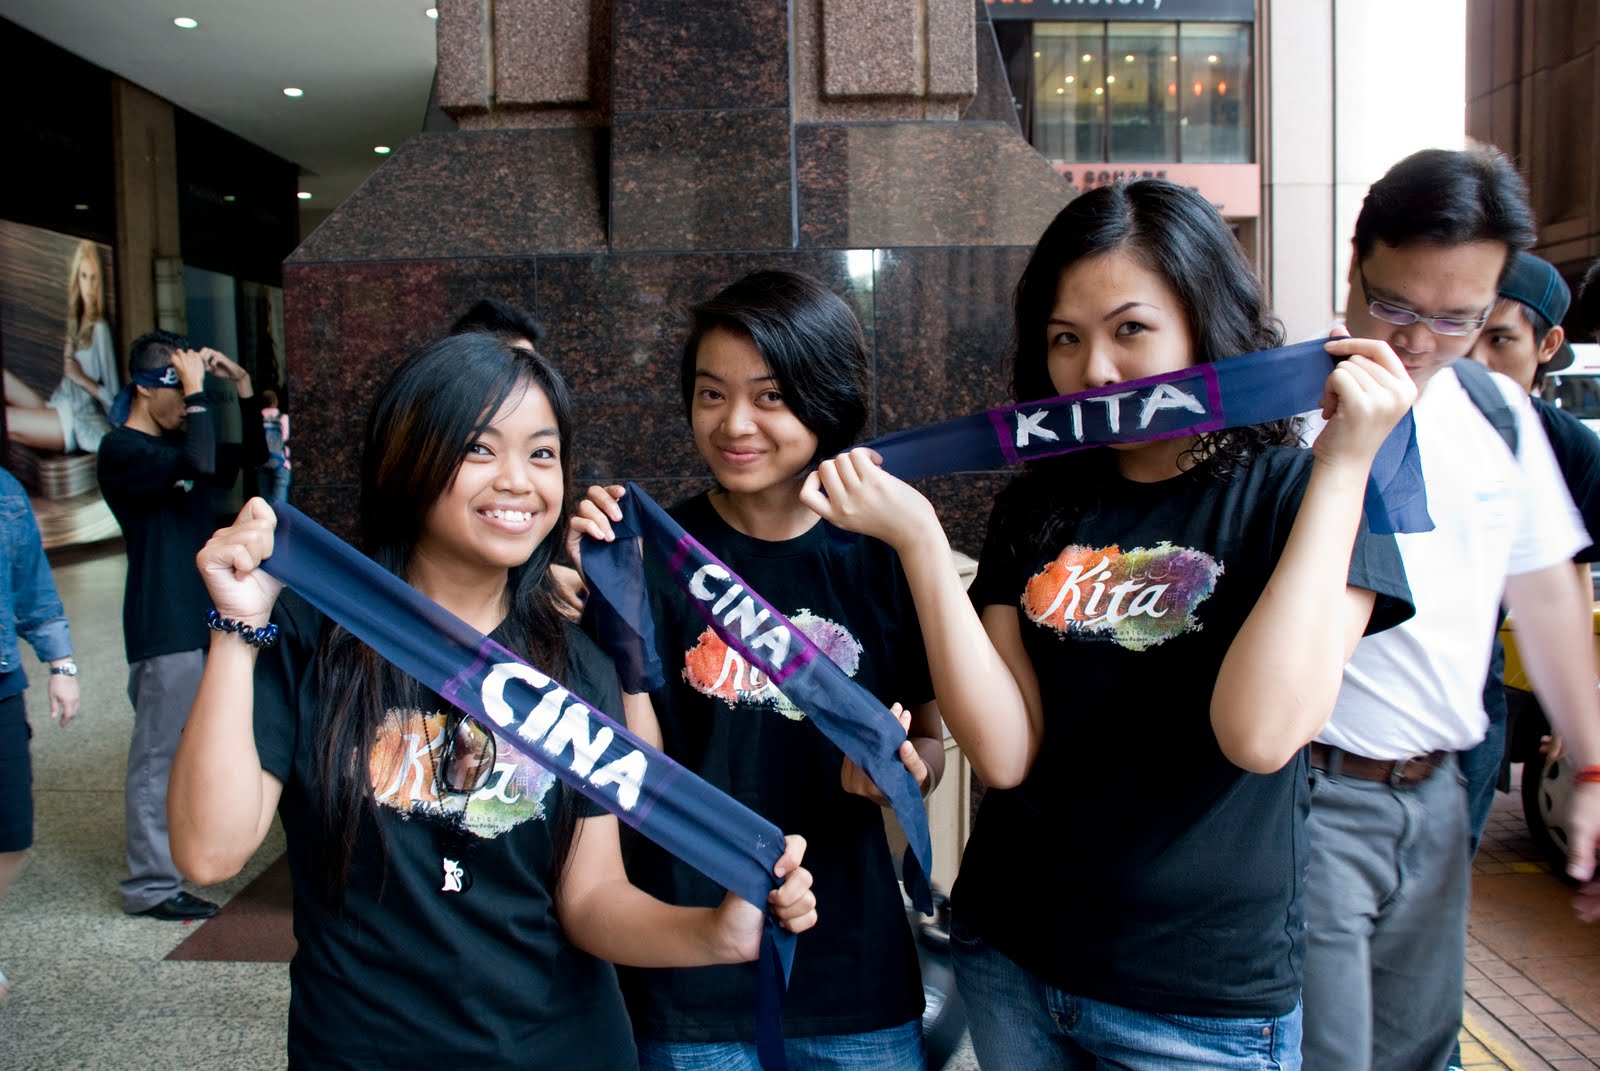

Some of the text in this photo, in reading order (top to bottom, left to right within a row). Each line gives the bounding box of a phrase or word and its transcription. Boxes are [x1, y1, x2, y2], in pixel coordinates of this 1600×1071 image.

[1014, 383, 1206, 448] KITA
[688, 563, 791, 670] CINA
[1035, 555, 1172, 625] Kita
[480, 661, 648, 812] CINA
